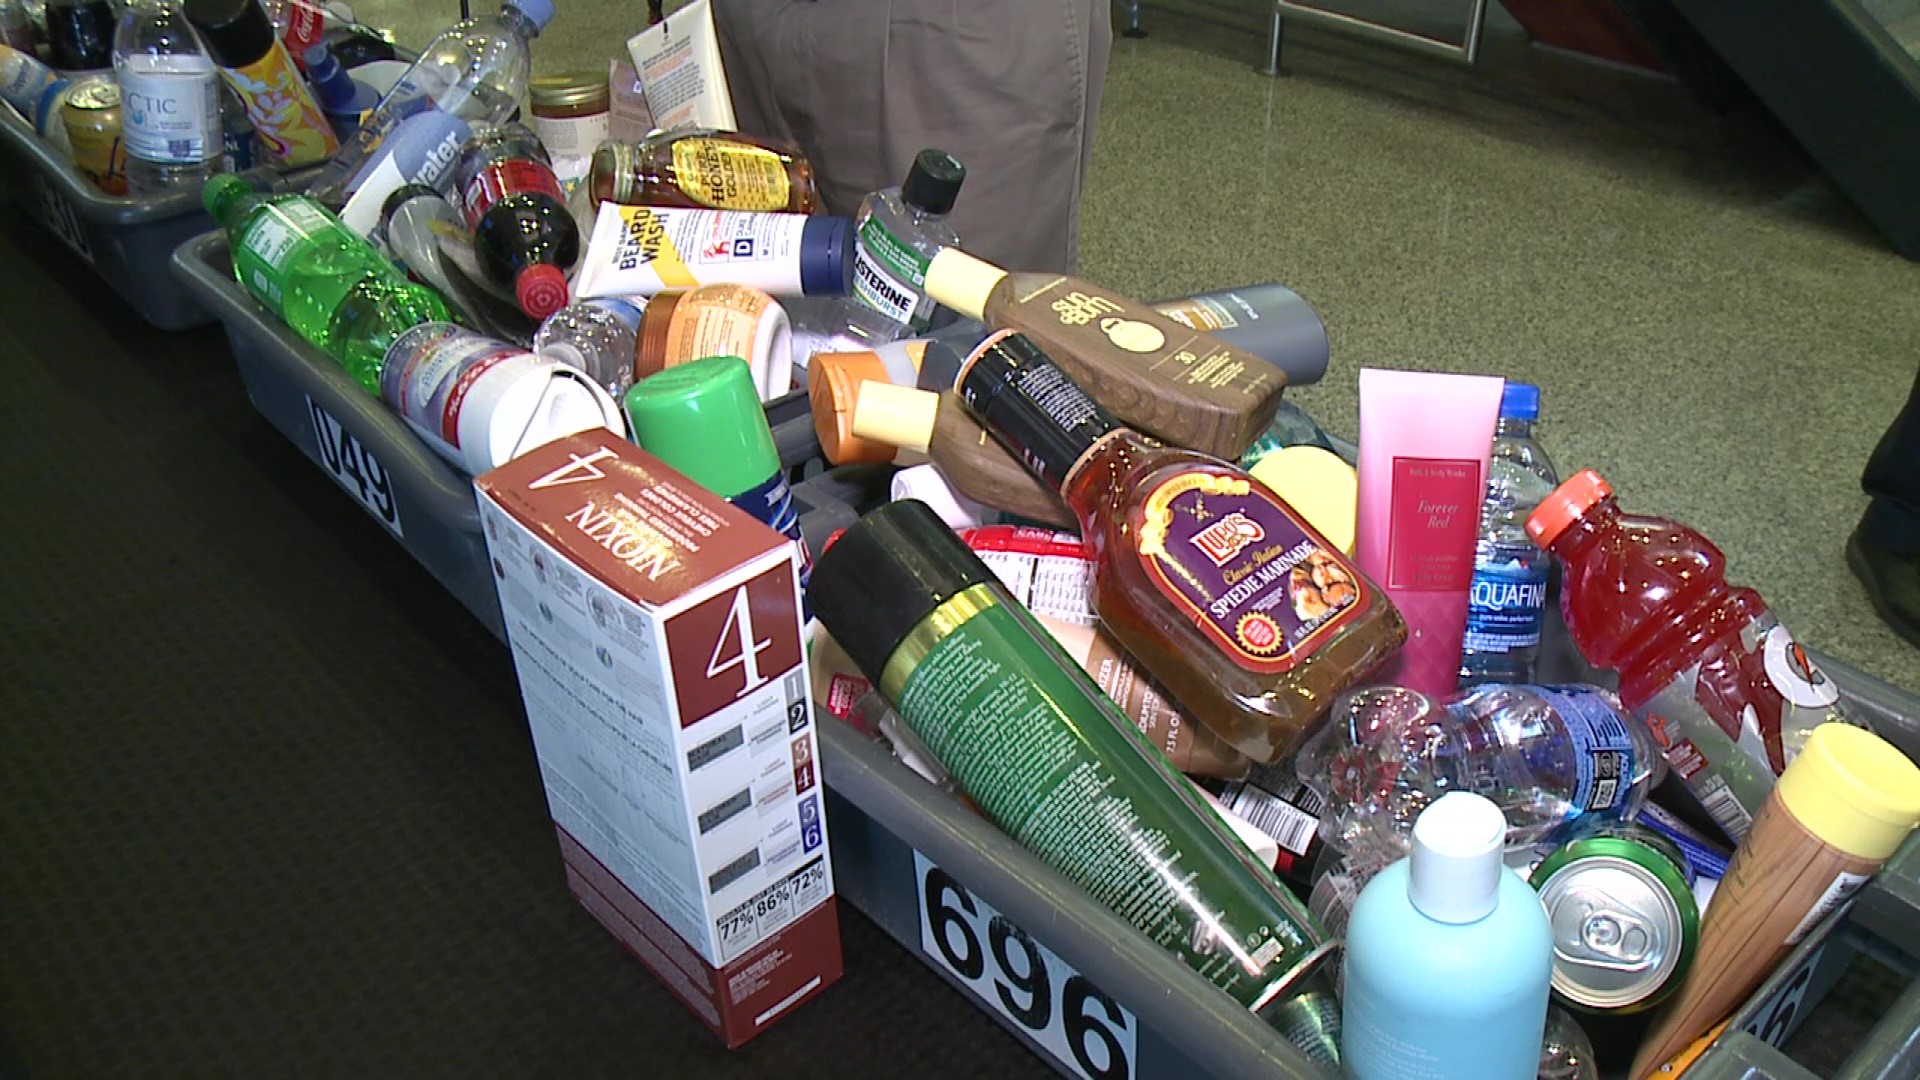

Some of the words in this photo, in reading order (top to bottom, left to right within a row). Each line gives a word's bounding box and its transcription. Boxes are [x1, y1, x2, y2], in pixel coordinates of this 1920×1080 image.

[619, 209, 651, 270] BEARD
[640, 213, 670, 264] WASH
[528, 445, 619, 490] 4
[1417, 500, 1459, 515] Forever
[1427, 514, 1451, 529] Red
[566, 500, 682, 581] NIOXIN
[1210, 572, 1263, 620] SPIEDIE
[1261, 540, 1318, 587] MARINADE
[706, 584, 772, 698] 4
[789, 676, 798, 700] 1
[790, 704, 805, 729] 2
[794, 740, 808, 764] 3
[798, 767, 811, 788] 4
[802, 802, 815, 823] 5
[805, 825, 819, 847] 6
[792, 869, 823, 896] 72%
[756, 889, 790, 917] 86%
[720, 912, 753, 940] 77%
[925, 867, 1129, 1080] 696
